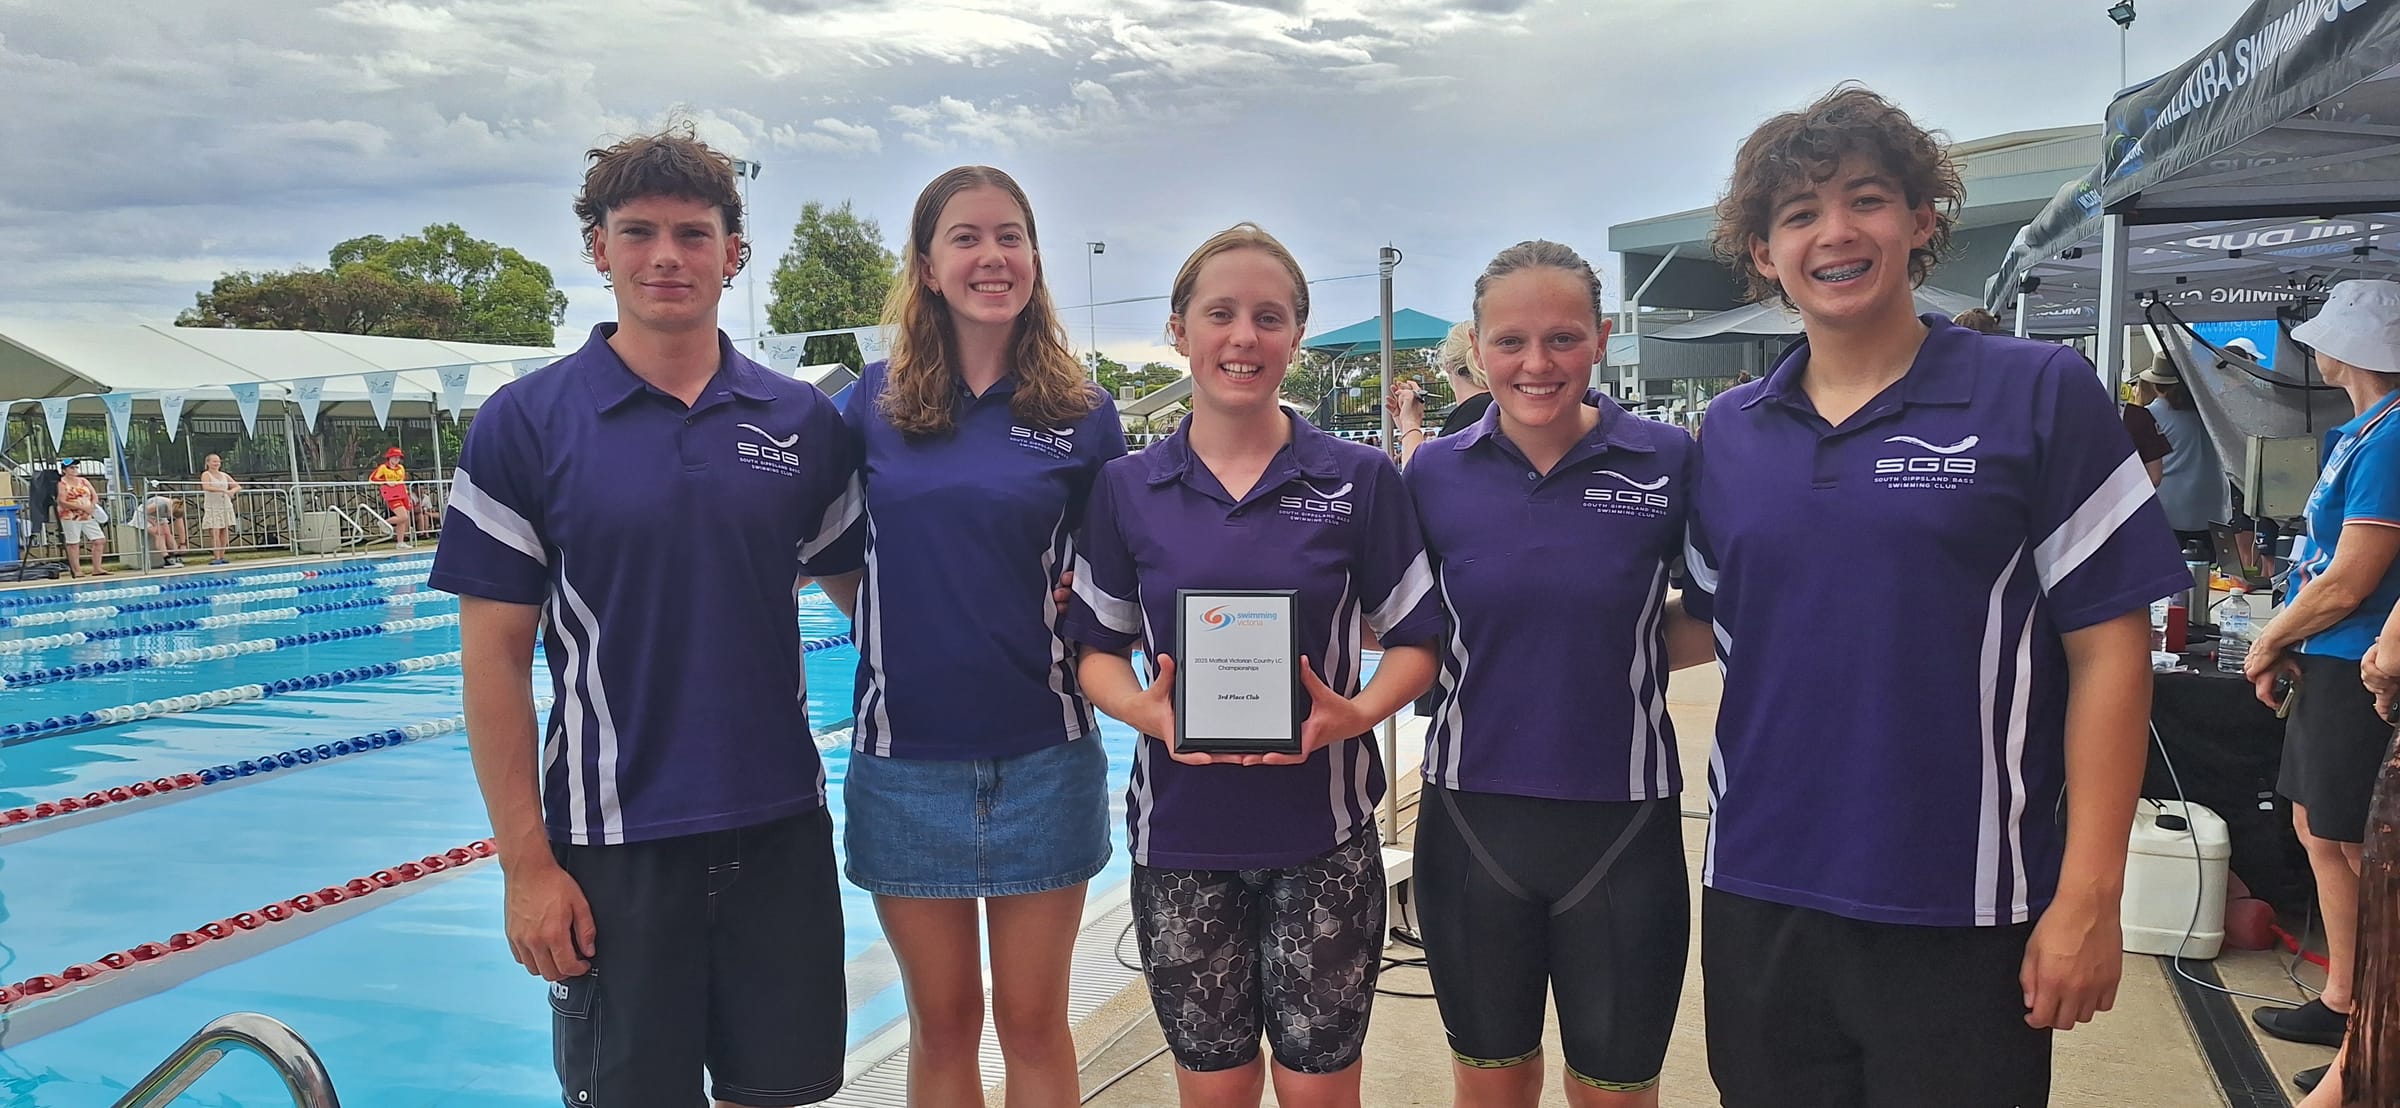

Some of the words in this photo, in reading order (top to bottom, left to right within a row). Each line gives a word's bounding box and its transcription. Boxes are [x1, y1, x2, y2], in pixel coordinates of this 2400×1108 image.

[2156, 51, 2232, 129] MILDURA
[1009, 426, 1073, 453] SGB
[737, 441, 799, 466] SGB
[1875, 457, 1977, 474] SGB
[1280, 496, 1352, 515] SGB
[1583, 488, 1668, 508] SGB
[1597, 508, 1635, 516] SWIMMING
[1237, 611, 1278, 621] swimming
[1253, 657, 1274, 665] Country
